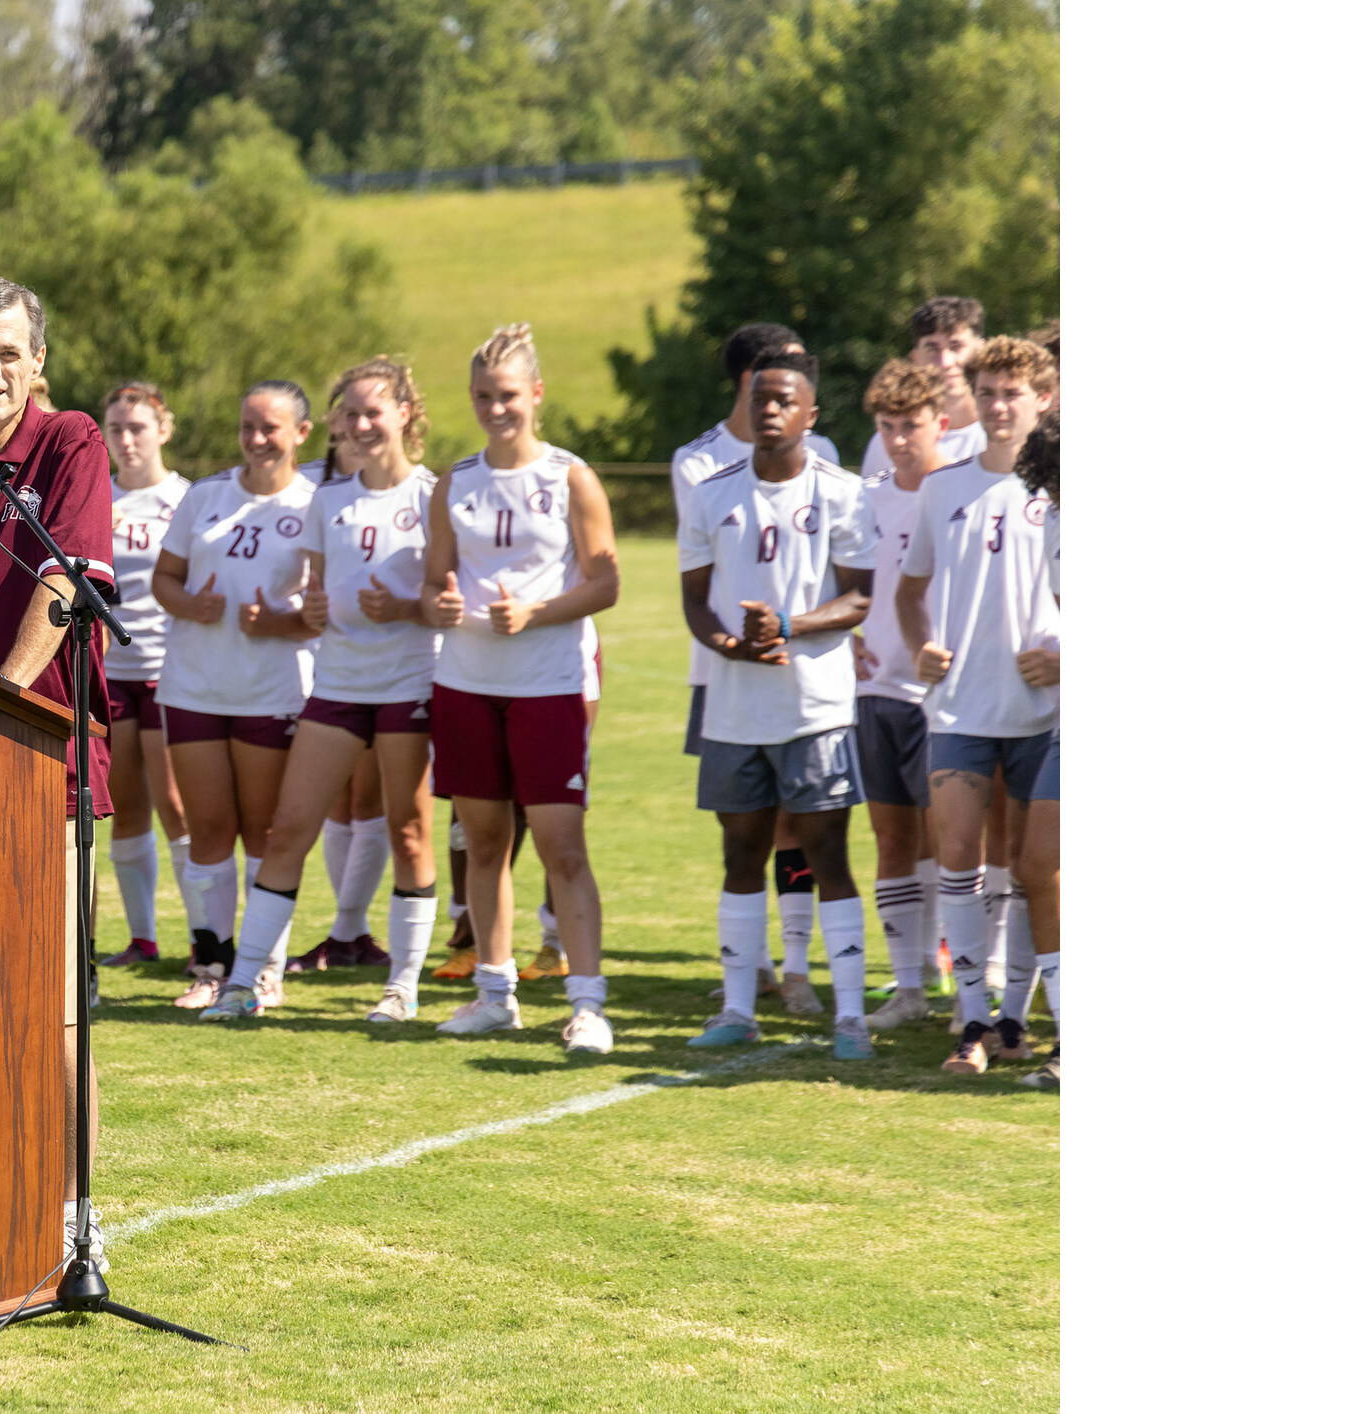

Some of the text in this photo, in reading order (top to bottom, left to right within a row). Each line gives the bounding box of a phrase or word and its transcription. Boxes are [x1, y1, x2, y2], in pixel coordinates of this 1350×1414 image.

[126, 523, 149, 551] 13
[226, 524, 263, 559] 23
[360, 525, 377, 562] 9
[495, 509, 513, 548] 11
[757, 525, 779, 563] 10
[988, 515, 1004, 552] 3
[816, 730, 849, 778] 10
